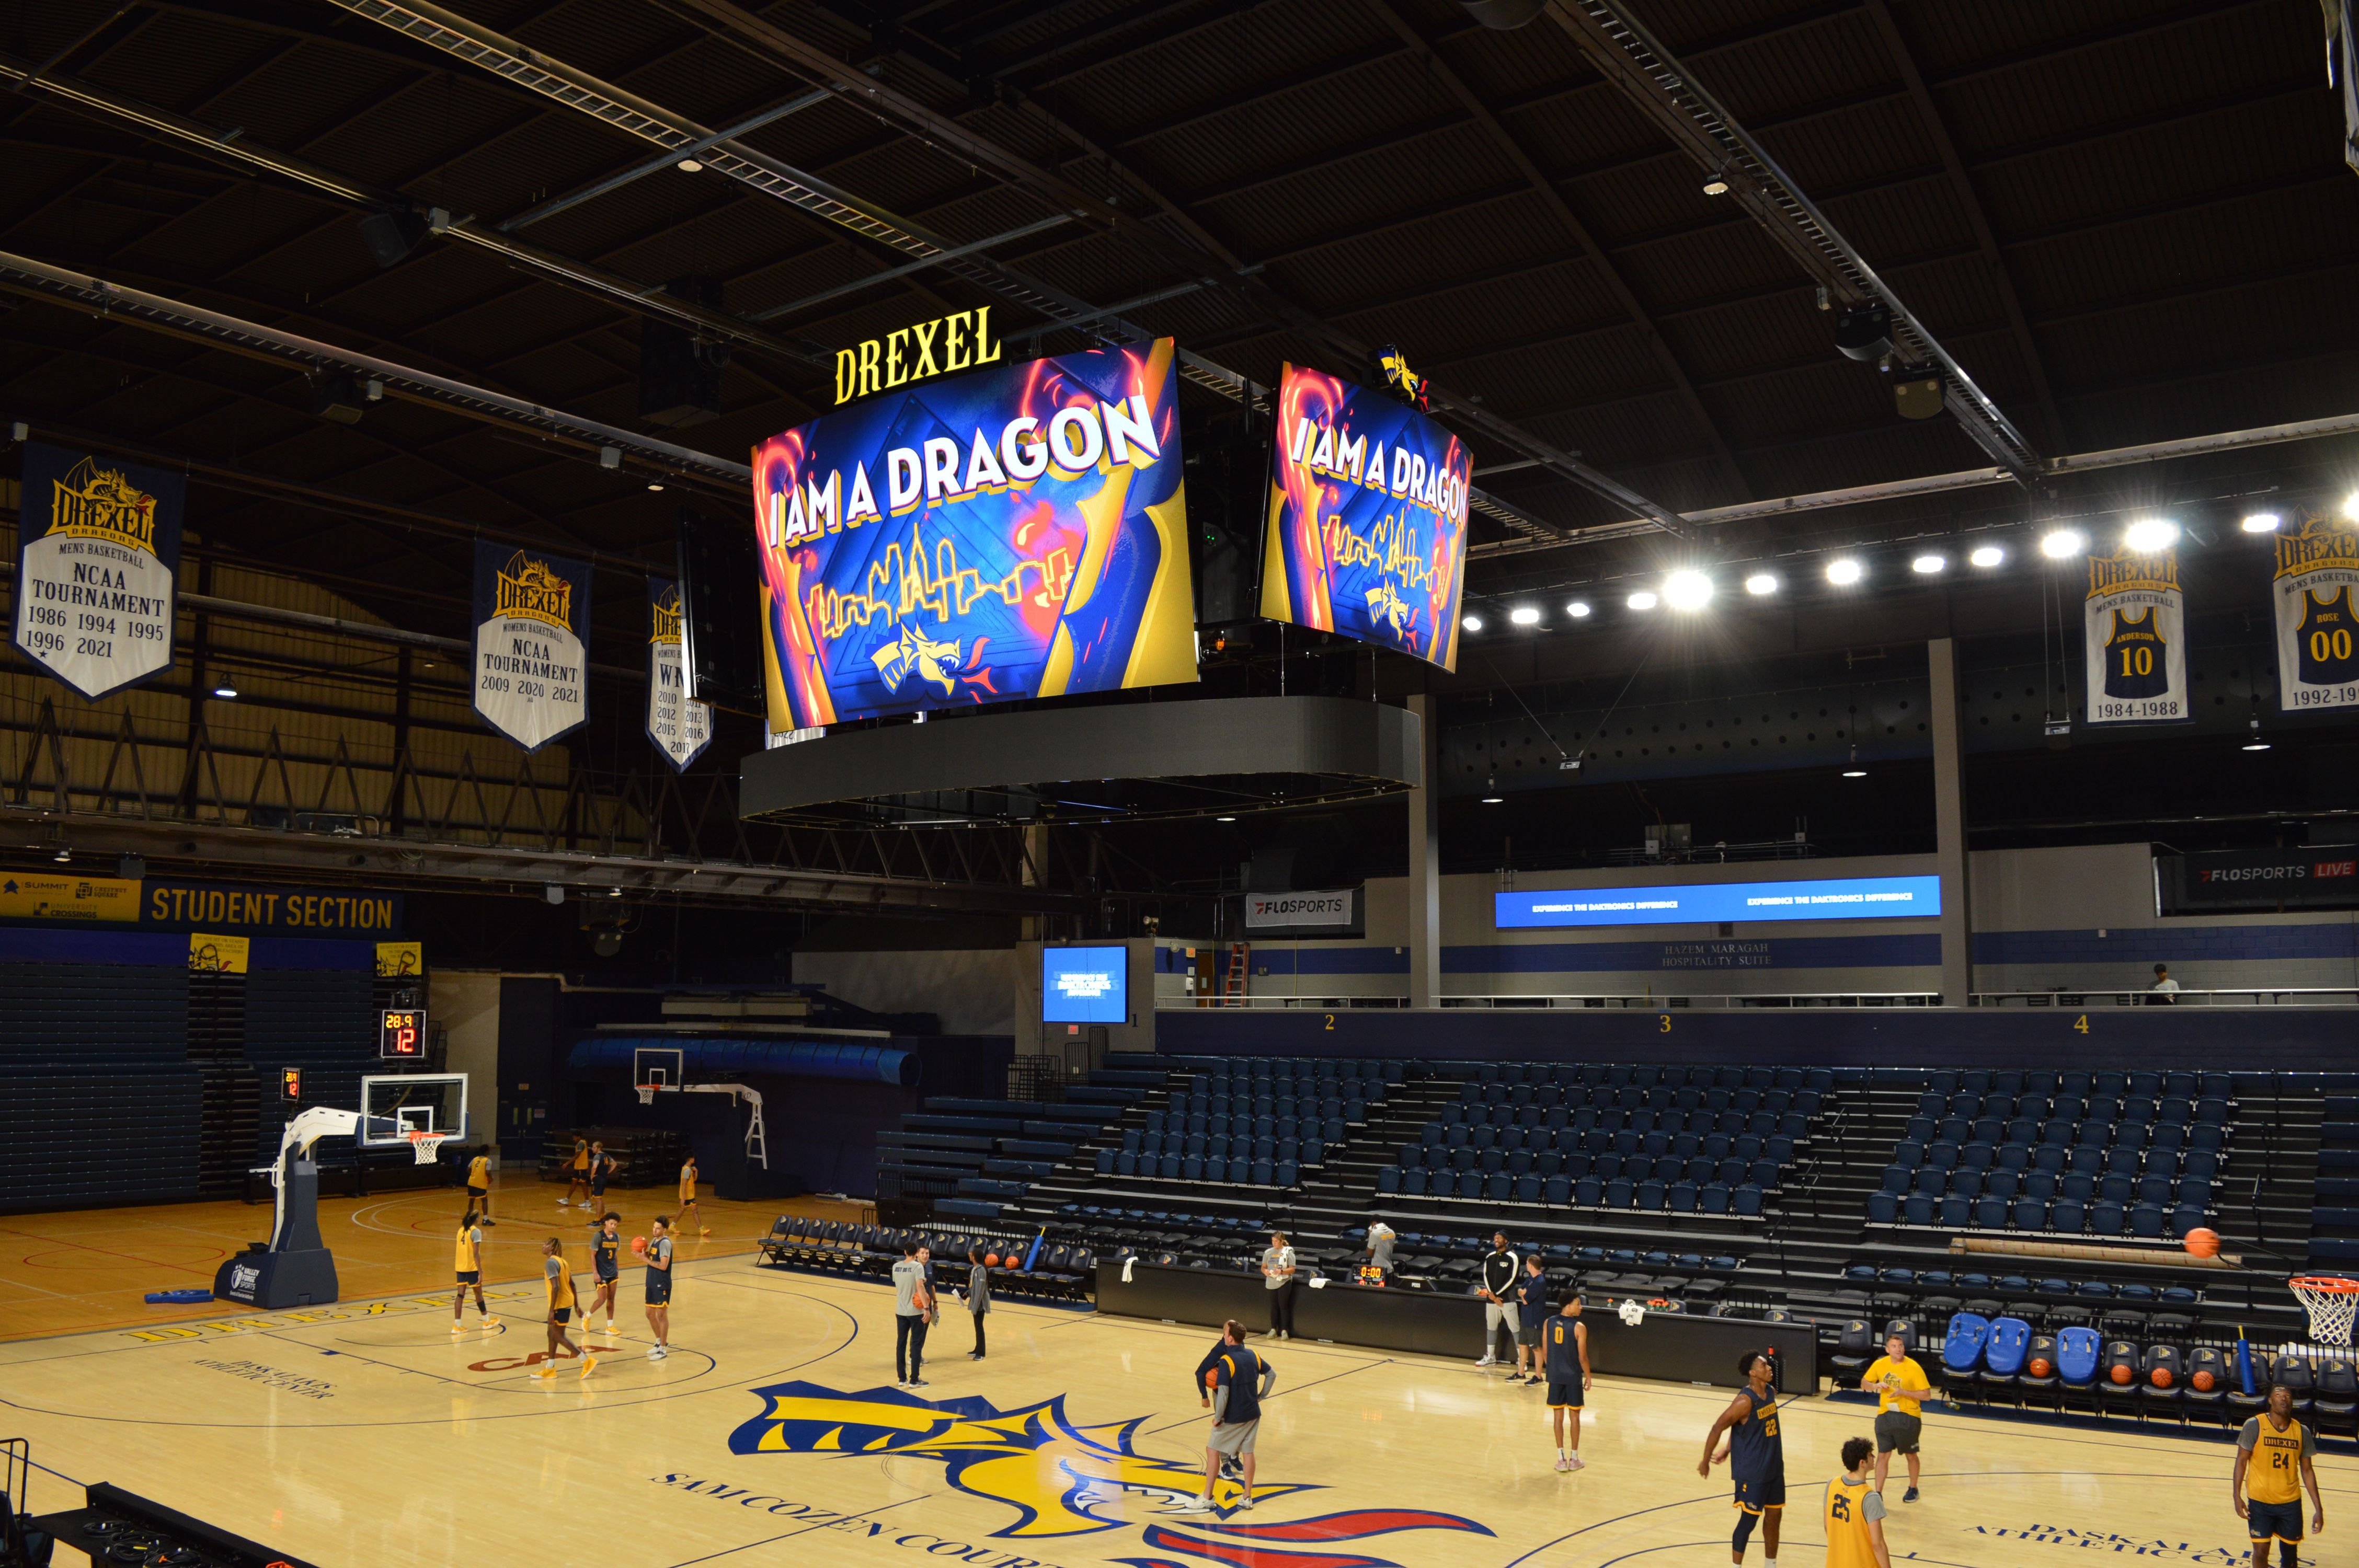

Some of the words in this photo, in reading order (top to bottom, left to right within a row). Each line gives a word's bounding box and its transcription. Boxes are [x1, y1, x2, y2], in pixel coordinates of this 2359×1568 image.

[833, 305, 1001, 405] DREXEL
[784, 469, 839, 543] AM
[846, 460, 879, 525] A
[887, 394, 1162, 512] DRAGON
[1292, 417, 1309, 462] I
[1310, 425, 1364, 480] AM
[1365, 440, 1385, 489] A
[1392, 446, 1467, 525] DRAGON
[55, 487, 153, 545] DREXEL
[59, 543, 85, 555] MENS
[88, 544, 144, 570] BASKETBALL
[73, 561, 126, 591] NCAA
[2285, 577, 2308, 596] MENS
[32, 579, 165, 617] TOURNAMENT
[500, 576, 570, 621] DREXEL
[2095, 598, 2117, 615] MENS
[2120, 593, 2176, 609] BASKETBALL
[28, 605, 66, 627] 1986
[78, 613, 116, 635] 1994
[128, 621, 163, 641] 1995
[2316, 613, 2340, 624] ROSE
[502, 622, 527, 633] WOMENS
[528, 624, 563, 644] BASKETBALL
[2116, 632, 2155, 644] ANDERSON
[27, 630, 65, 651] 1996
[77, 637, 112, 658] 2021
[512, 638, 551, 661] NCAA
[2310, 628, 2352, 662] 00
[657, 650, 676, 659] WOMENS
[2120, 646, 2153, 677] 10
[484, 653, 578, 683] TOURNAMENT
[482, 675, 510, 693] 2009
[518, 680, 544, 698] 2020
[552, 686, 578, 703] 2021
[658, 690, 677, 704] 2010
[2293, 687, 2359, 707] 1992-19
[657, 706, 676, 720] 2012
[685, 710, 703, 723] 2013
[2098, 701, 2178, 718] 1984-1988
[656, 722, 676, 736] 2015
[685, 727, 703, 739] 2016
[670, 741, 690, 754] 2017
[2211, 865, 2306, 882] FLOSPORTS
[2317, 862, 2352, 877] LIVE
[25, 882, 69, 890] SUMMIT
[151, 887, 280, 925] STUDENT
[285, 895, 393, 929] SECTION
[1265, 899, 1343, 915] FLOSPORTS
[1532, 904, 1573, 913] EXPERIENCE
[1588, 902, 1635, 911] DAKTRONICS
[1635, 901, 1678, 909] DIFFERENCE
[1747, 896, 1793, 906] EXPERIENCE
[1794, 896, 1810, 905] THE
[1811, 893, 1864, 904] DAKTRONICS
[1864, 892, 1913, 902] DIFFERENCE
[50, 910, 97, 919] CROSSINGS
[1665, 944, 1704, 954] HAZEM
[1711, 943, 1769, 953] MARAGAH
[1662, 956, 1733, 967] HOSPITALITY
[1739, 955, 1772, 965] SUITE
[386, 1014, 413, 1029] 28.9
[1132, 1013, 1138, 1028] 1
[1325, 1014, 1335, 1030] 2
[1659, 1014, 1671, 1033] 3
[2074, 1015, 2089, 1034] 4
[397, 1029, 415, 1053] 12
[289, 1082, 297, 1096] 12
[608, 1250, 613, 1259] 3
[242, 1274, 256, 1283] FORGE
[244, 1267, 260, 1277] VALLEY
[1361, 1266, 1381, 1278] 0:00
[240, 1281, 256, 1290] SPORTS
[1554, 1326, 1564, 1344] 0
[1766, 1419, 1778, 1437] 22
[2264, 1437, 2298, 1448] DREXEL
[2273, 1452, 2289, 1470] 24
[1831, 1493, 1851, 1523] 25
[648, 1473, 753, 1500] SAM
[740, 1495, 900, 1538] COZEN
[895, 1534, 1068, 1568] COUR
[1961, 1525, 2183, 1559] ATHLETIC
